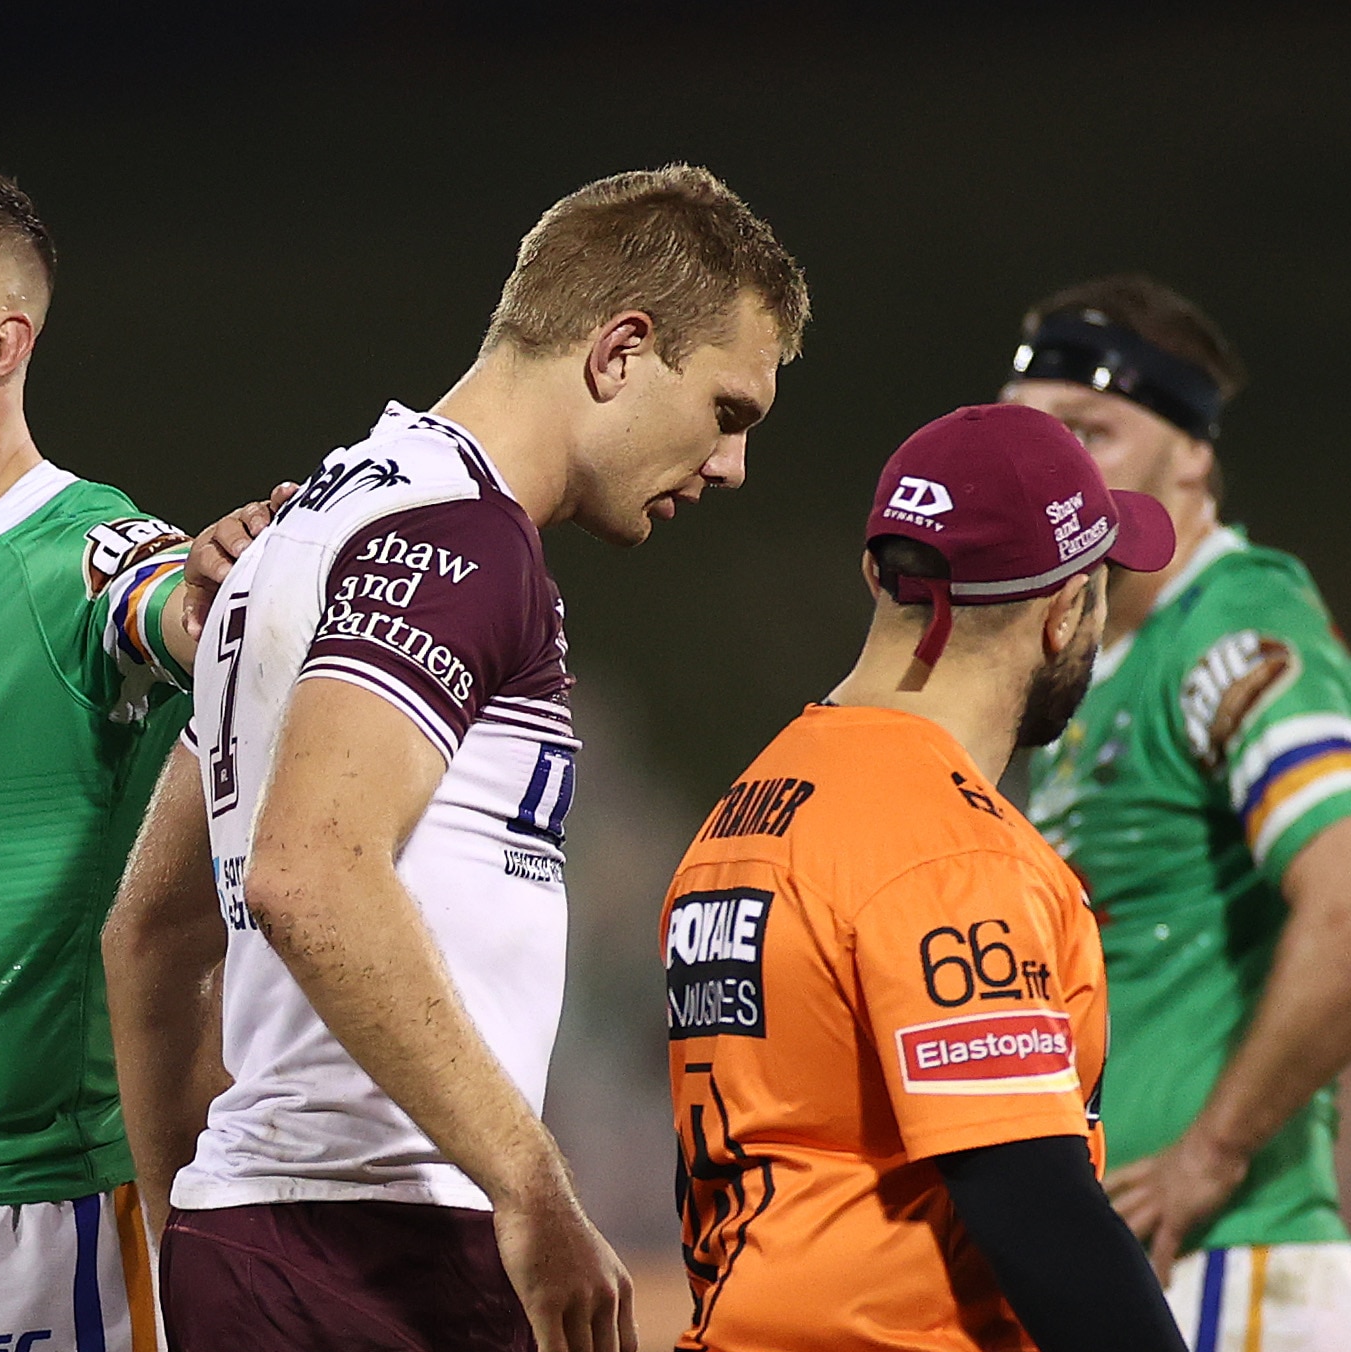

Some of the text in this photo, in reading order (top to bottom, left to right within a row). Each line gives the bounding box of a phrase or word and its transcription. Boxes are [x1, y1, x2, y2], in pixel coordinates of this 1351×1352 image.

[883, 508, 945, 532] DYNASTY
[1046, 491, 1083, 525] Shaw
[1054, 513, 1081, 542] and
[1058, 516, 1108, 562] Partners
[356, 531, 479, 584] shaw
[334, 572, 423, 608] and
[317, 600, 474, 701] Partners
[915, 1029, 1067, 1070] Elastoplas
